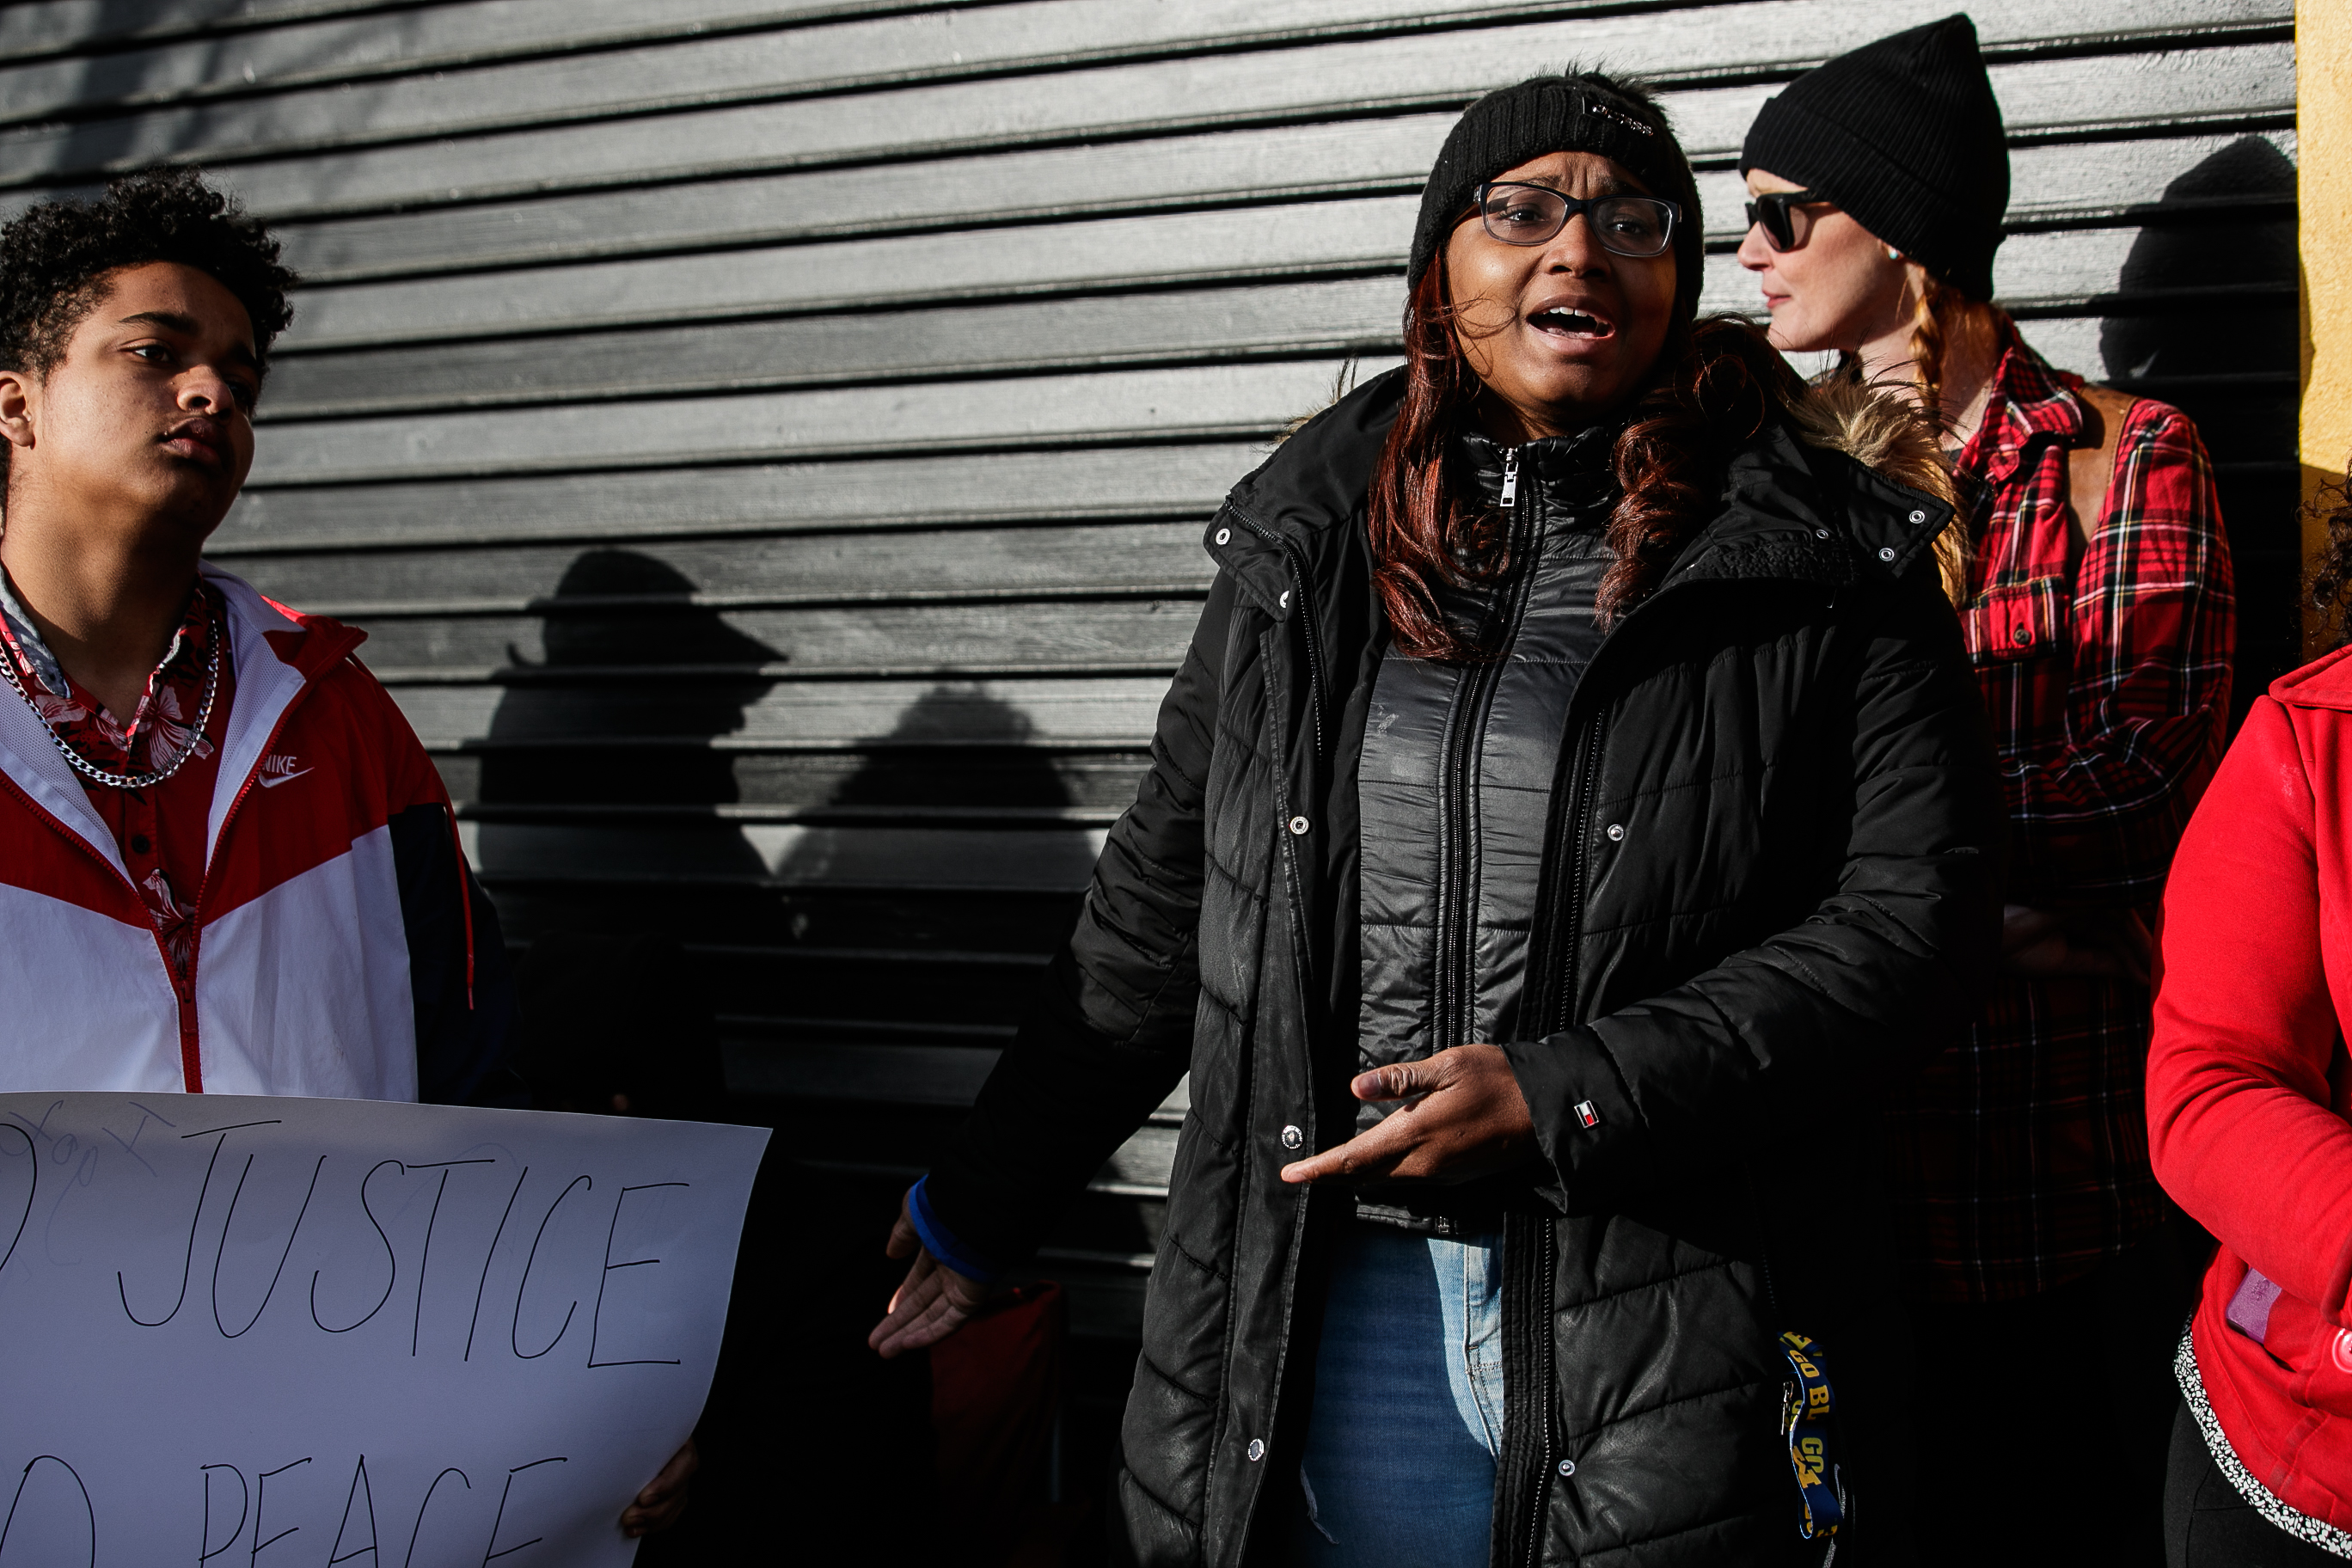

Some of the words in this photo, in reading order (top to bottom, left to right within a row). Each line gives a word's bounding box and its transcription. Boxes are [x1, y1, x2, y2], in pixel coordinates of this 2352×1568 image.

[262, 754, 297, 775] NIKE
[117, 1119, 689, 1369] JUSTICE
[1788, 1349, 1821, 1379] GO
